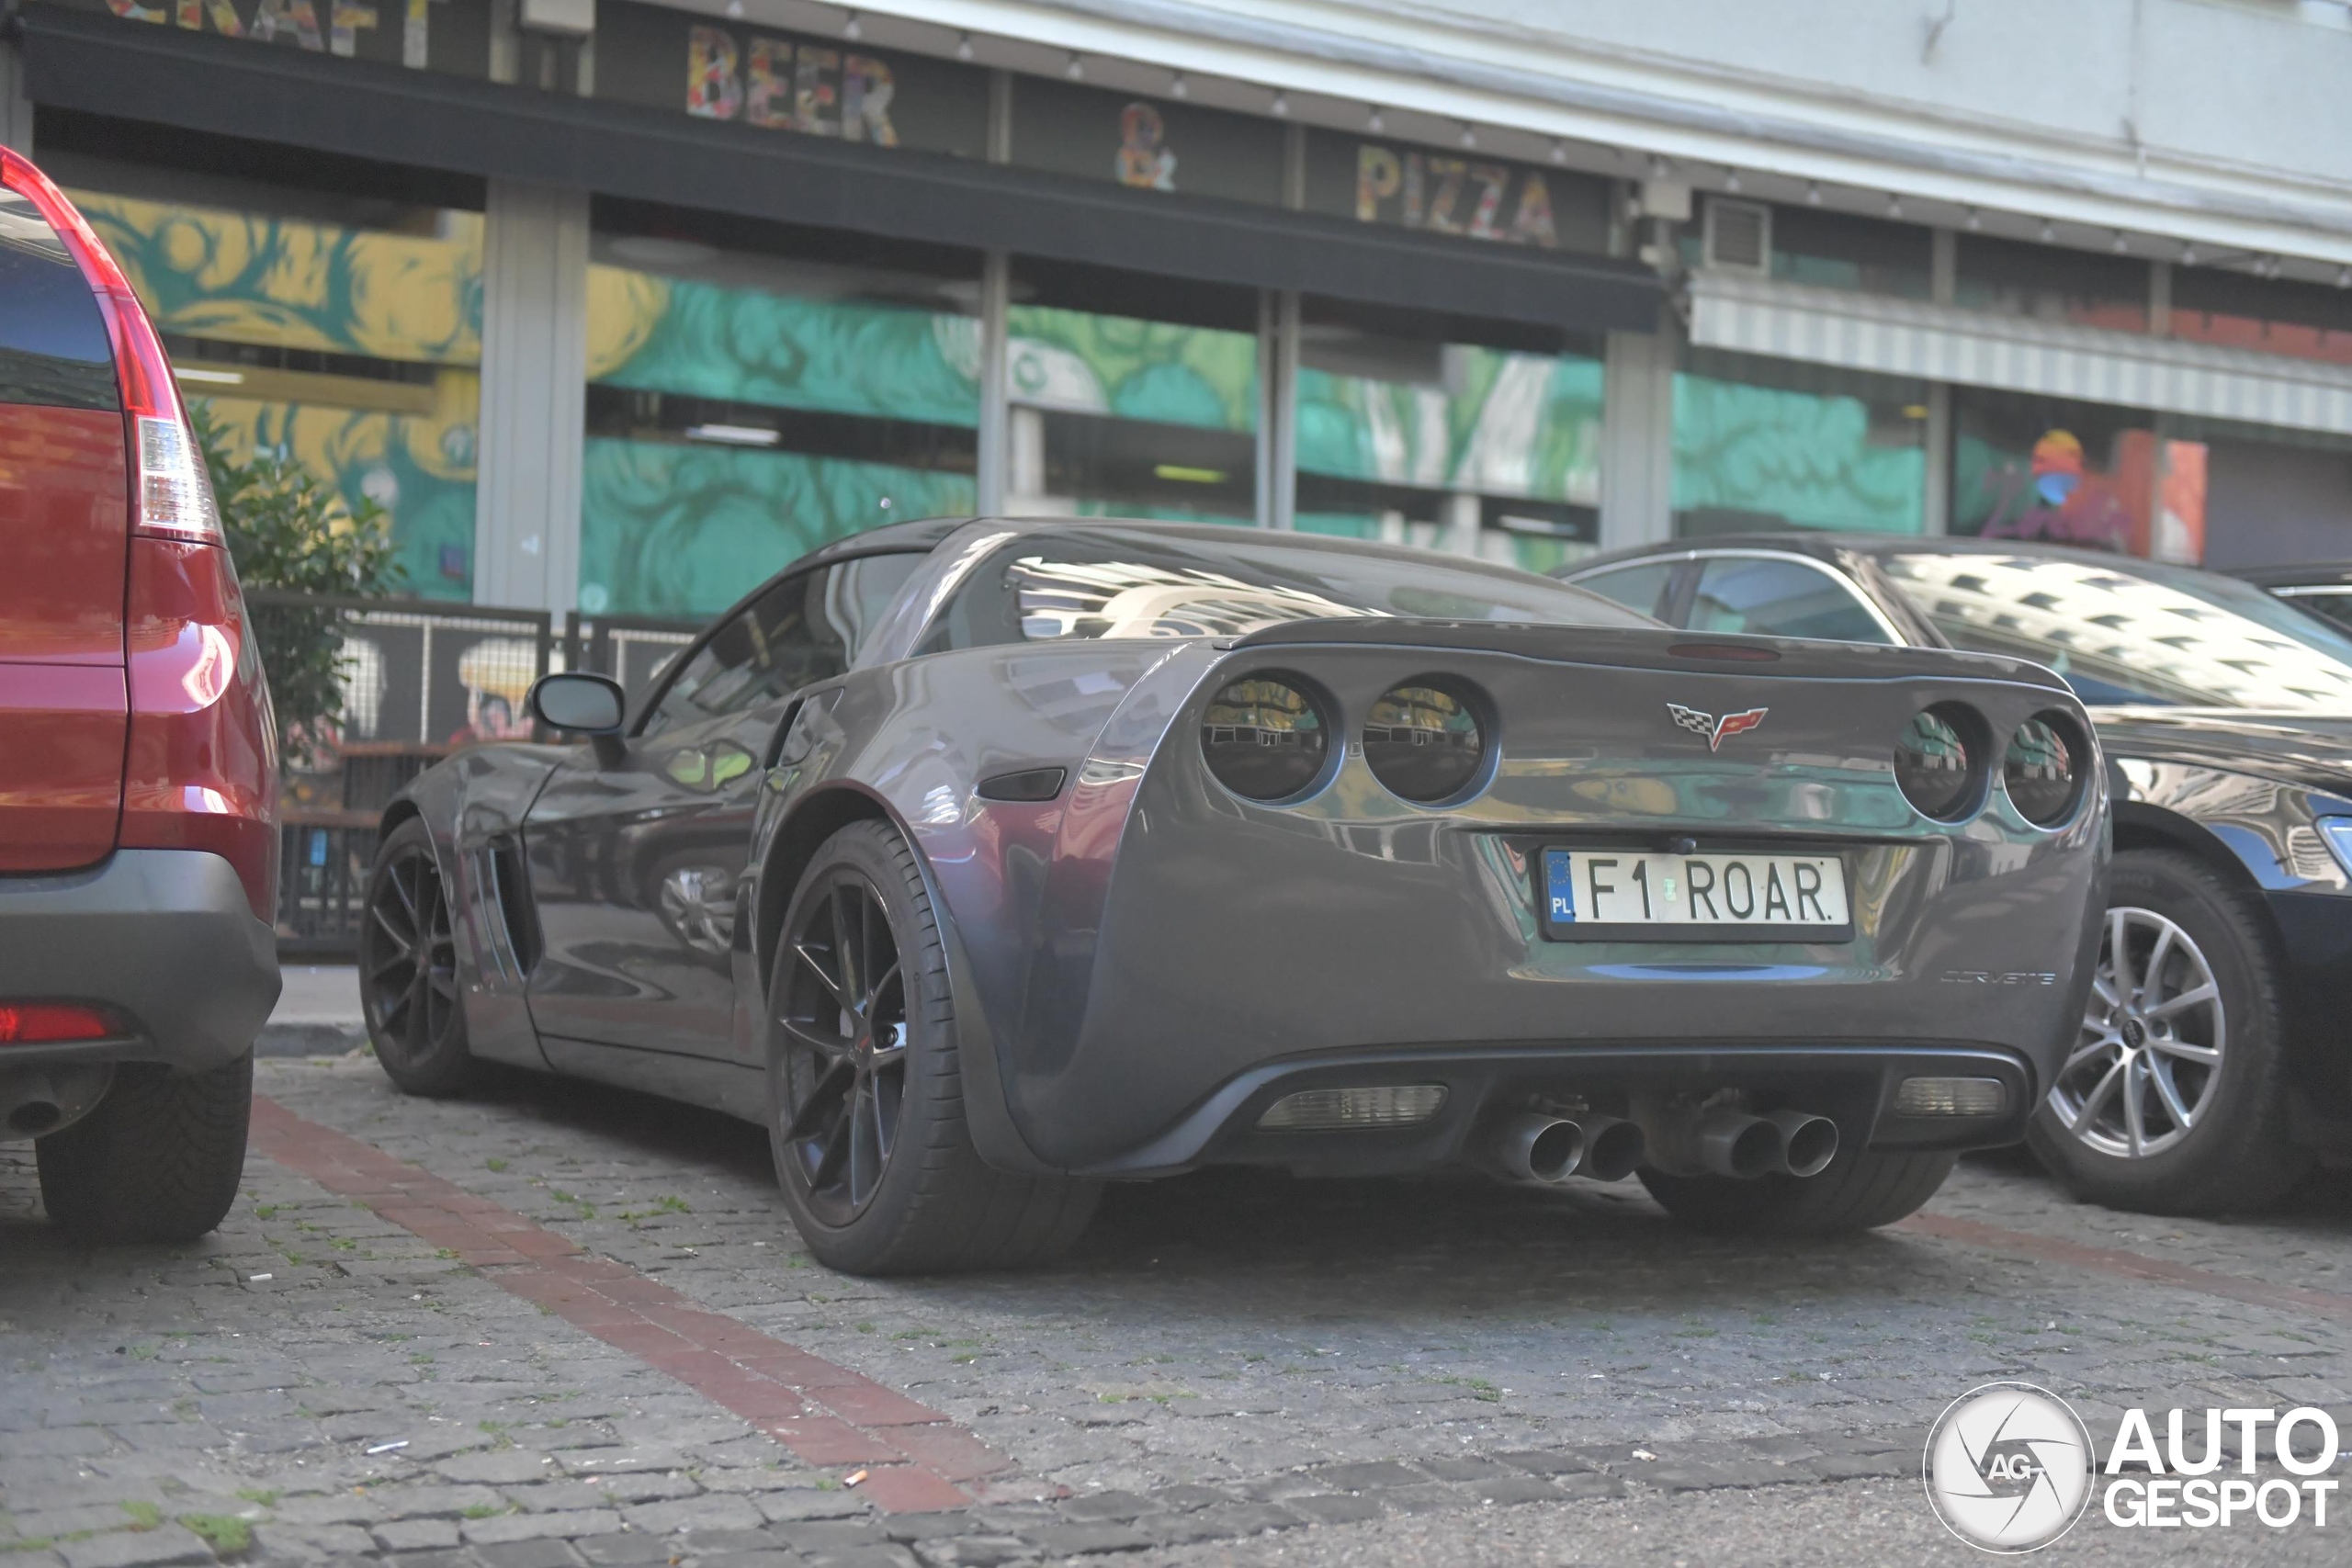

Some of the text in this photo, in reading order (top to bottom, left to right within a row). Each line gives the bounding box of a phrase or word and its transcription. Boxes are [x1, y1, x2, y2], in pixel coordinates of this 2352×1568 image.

[687, 24, 899, 148] BEER
[1114, 101, 1177, 192] &
[1355, 144, 1558, 248] PIZZA
[1552, 897, 1571, 914] PL
[1588, 859, 1827, 921] F1 ROAR
[1940, 970, 2056, 986] CORVETTE
